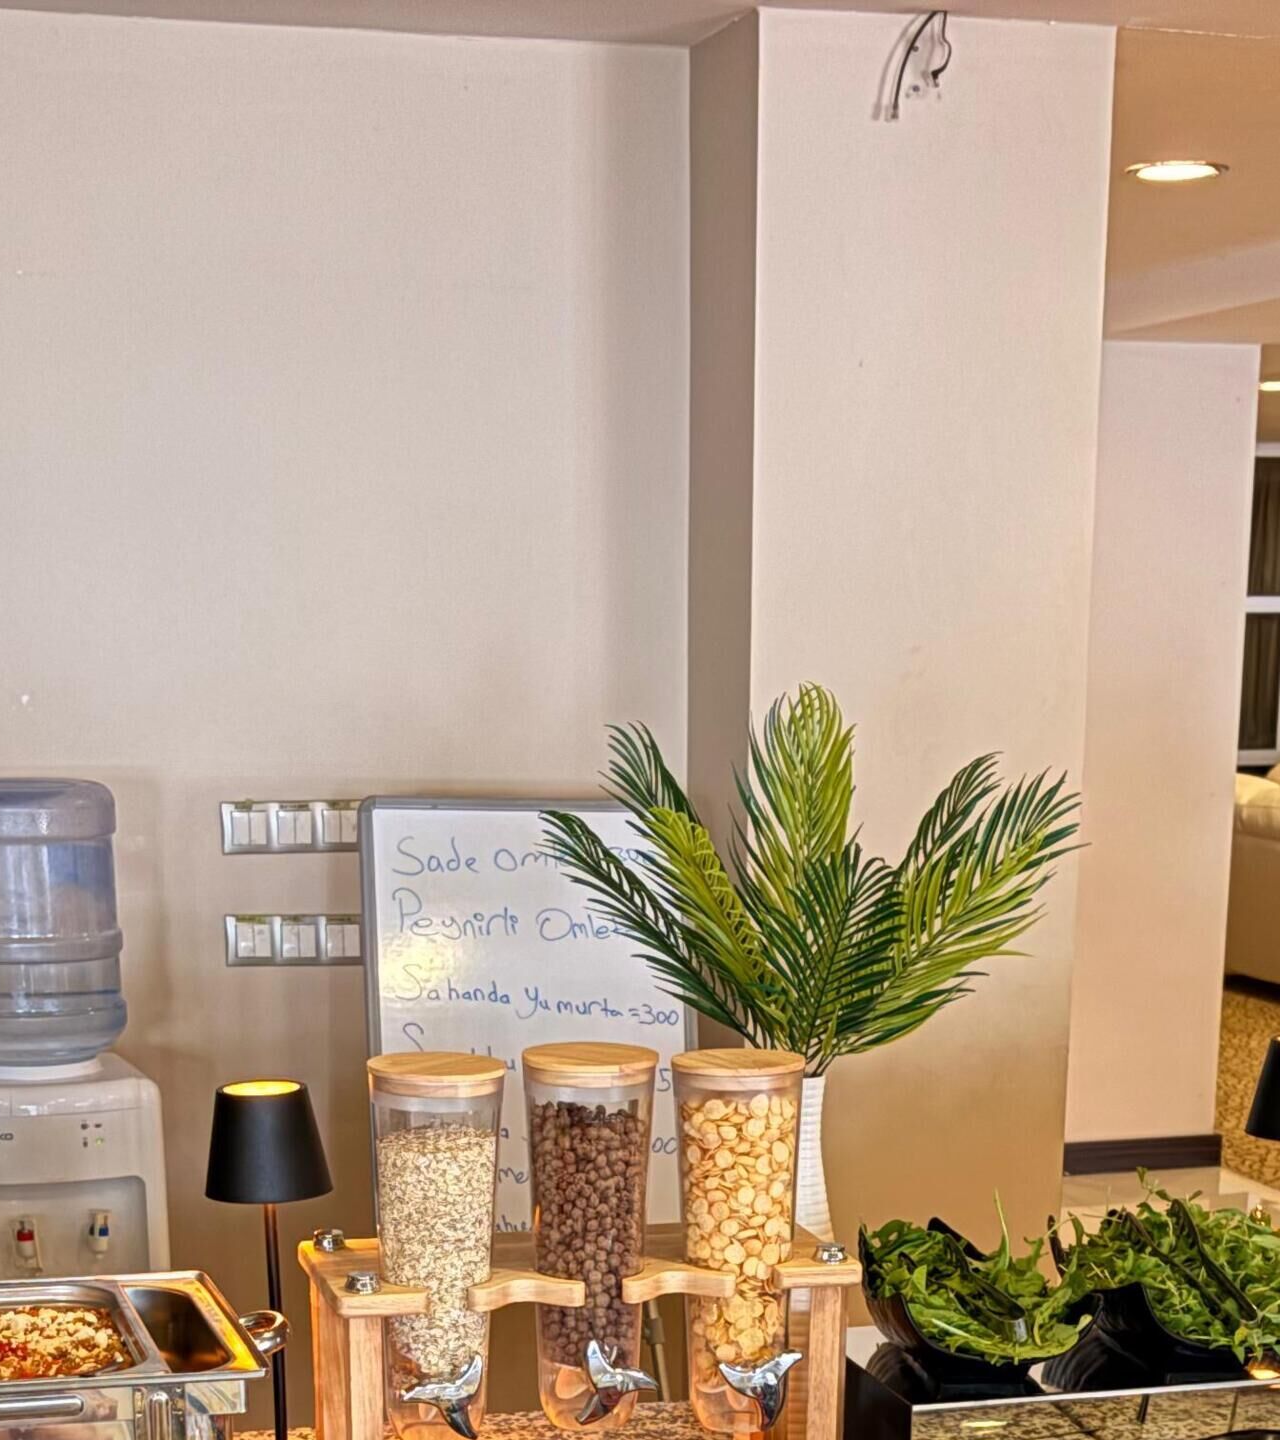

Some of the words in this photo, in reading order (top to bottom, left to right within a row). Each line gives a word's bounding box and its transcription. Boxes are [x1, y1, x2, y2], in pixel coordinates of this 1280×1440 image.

[392, 836, 480, 876] Sade
[392, 887, 519, 940] Peynirli
[395, 963, 512, 1004] Sahanda
